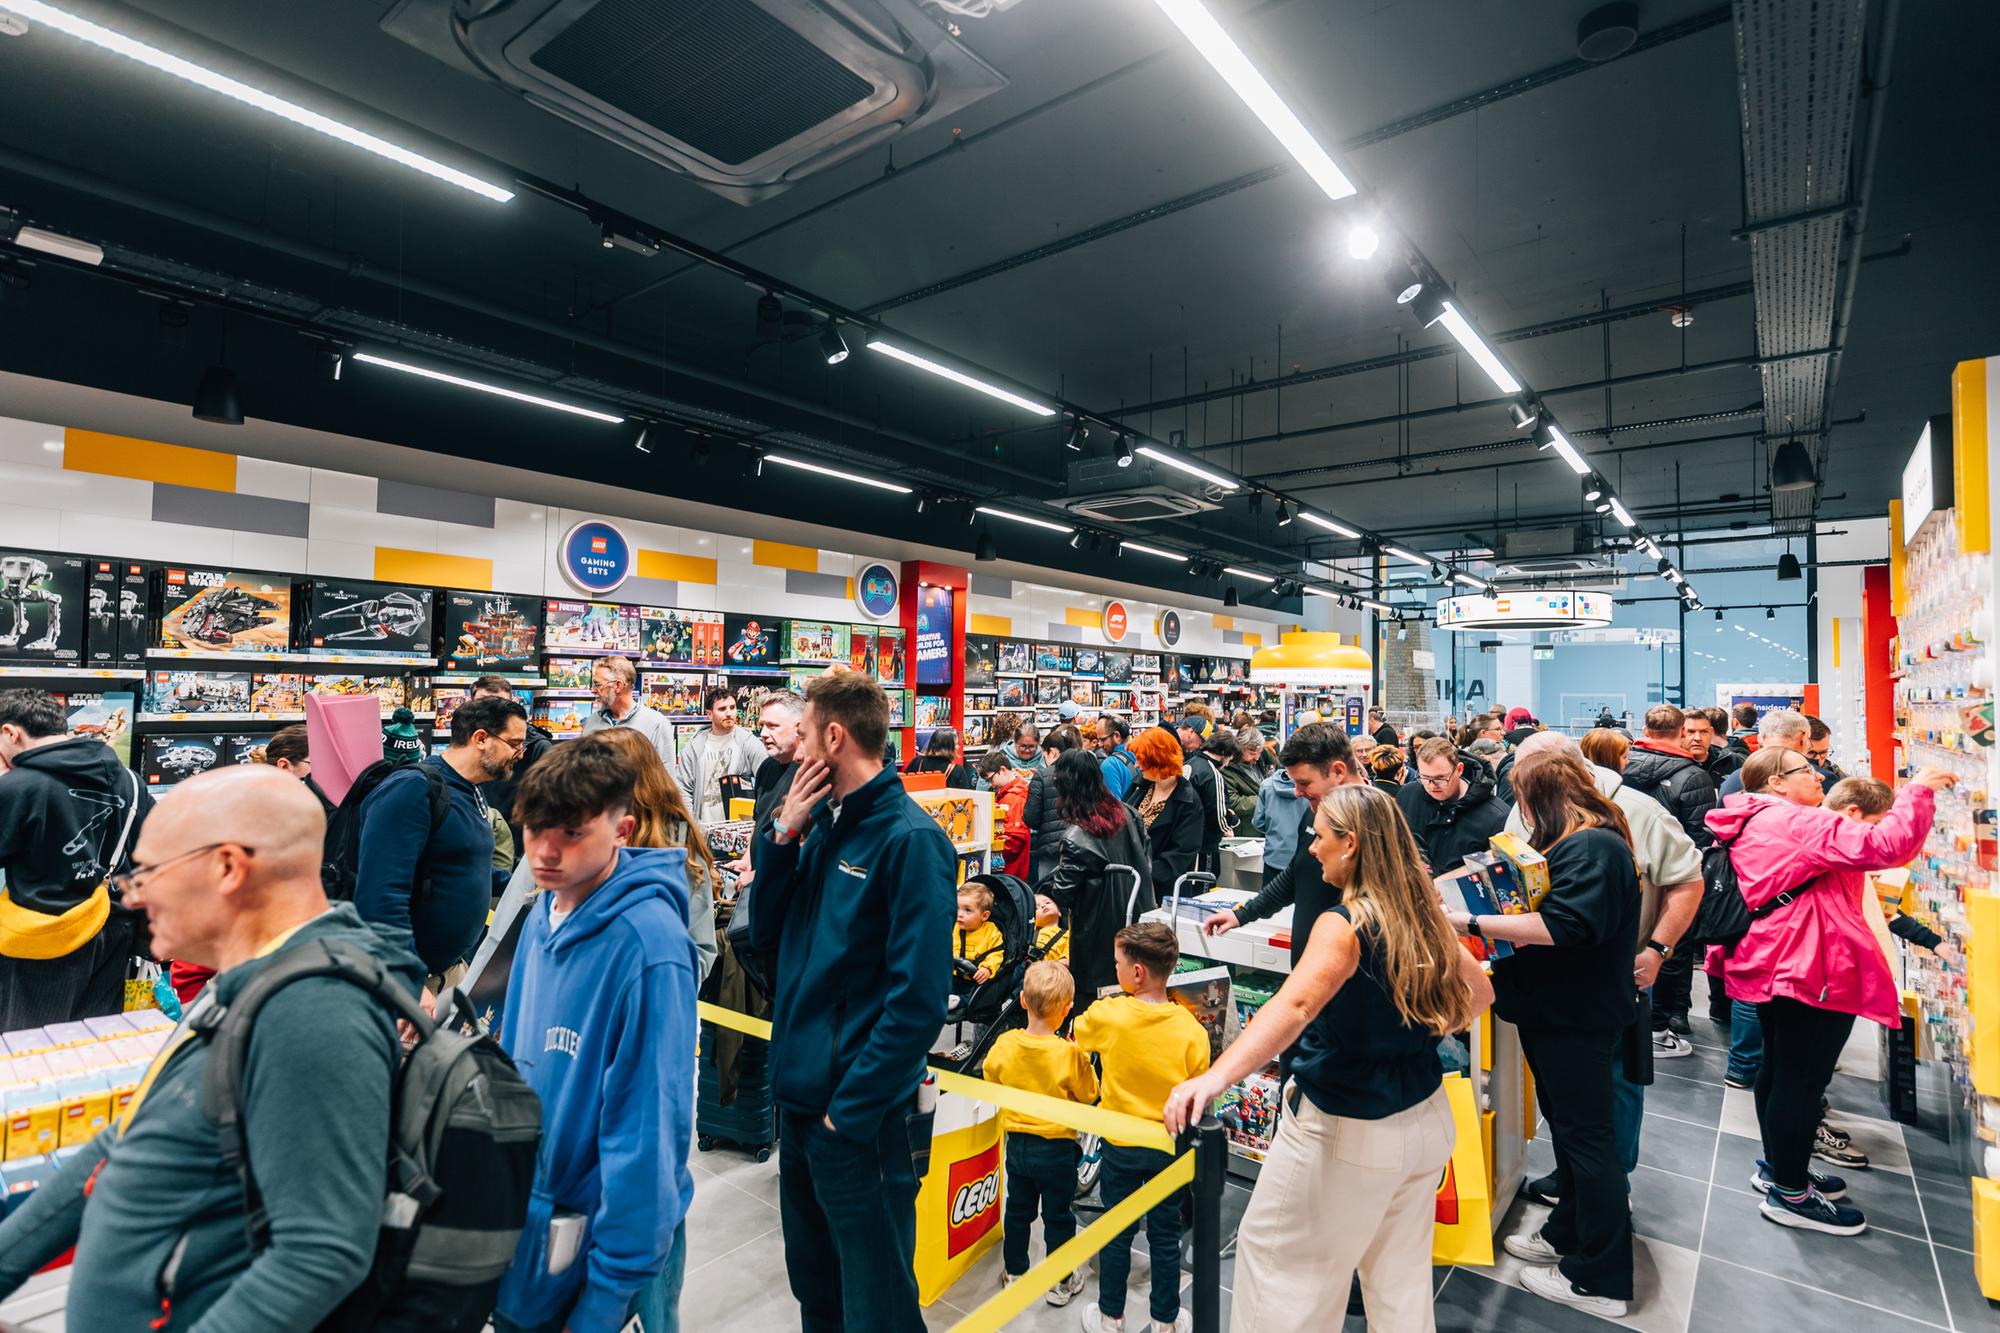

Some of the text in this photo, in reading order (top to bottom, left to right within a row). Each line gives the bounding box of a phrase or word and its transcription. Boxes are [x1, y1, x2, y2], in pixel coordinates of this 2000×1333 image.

[580, 556, 616, 568] GAMING
[192, 571, 224, 582] STAR
[587, 566, 609, 576] SETS
[917, 633, 941, 642] REATIVE
[933, 639, 945, 648] FOR
[917, 647, 948, 661] AMERS
[1753, 703, 1787, 711] Insiders
[393, 739, 421, 750] IREL
[951, 1166, 1000, 1226] LEGO
